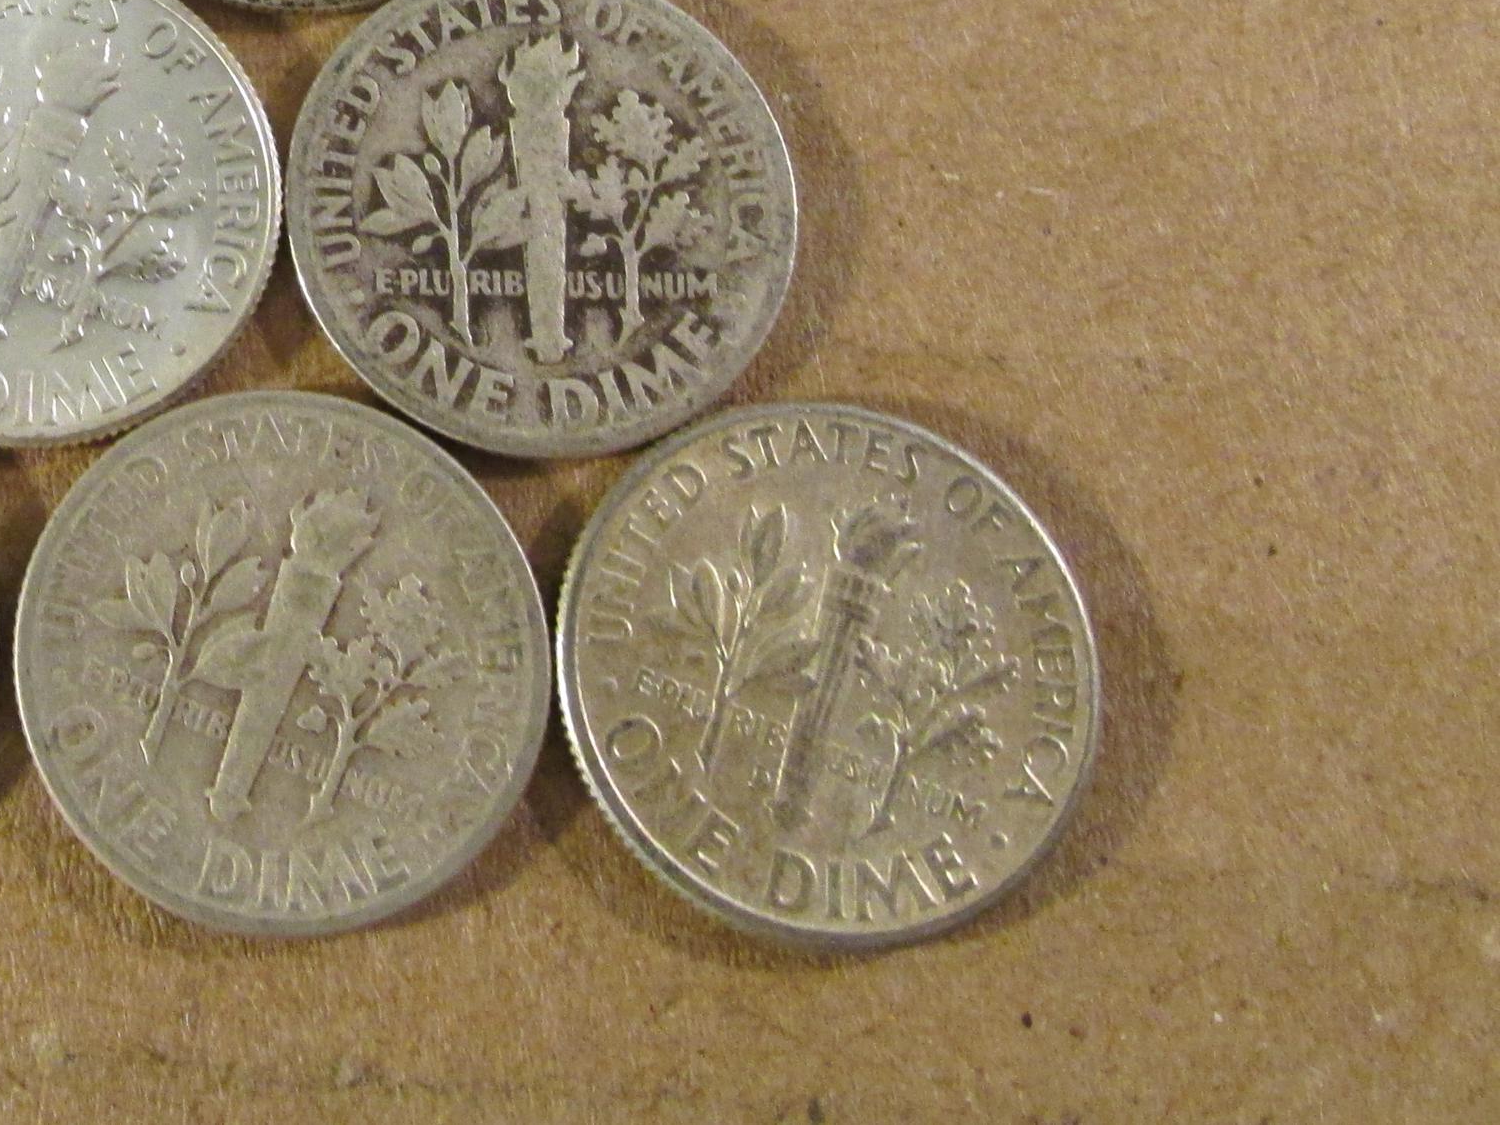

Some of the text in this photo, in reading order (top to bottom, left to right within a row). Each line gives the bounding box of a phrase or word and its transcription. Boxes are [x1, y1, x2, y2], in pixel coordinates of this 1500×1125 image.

[143, 17, 207, 75] OF
[183, 83, 263, 317] AMERICA
[312, 73, 382, 271] UNITED
[658, 47, 771, 263] AMERICA
[365, 308, 725, 427] ONE DIME
[587, 418, 1080, 806] UNITED STATES OF AMERICA
[200, 825, 412, 909] DIME
[766, 831, 981, 922] DIME
